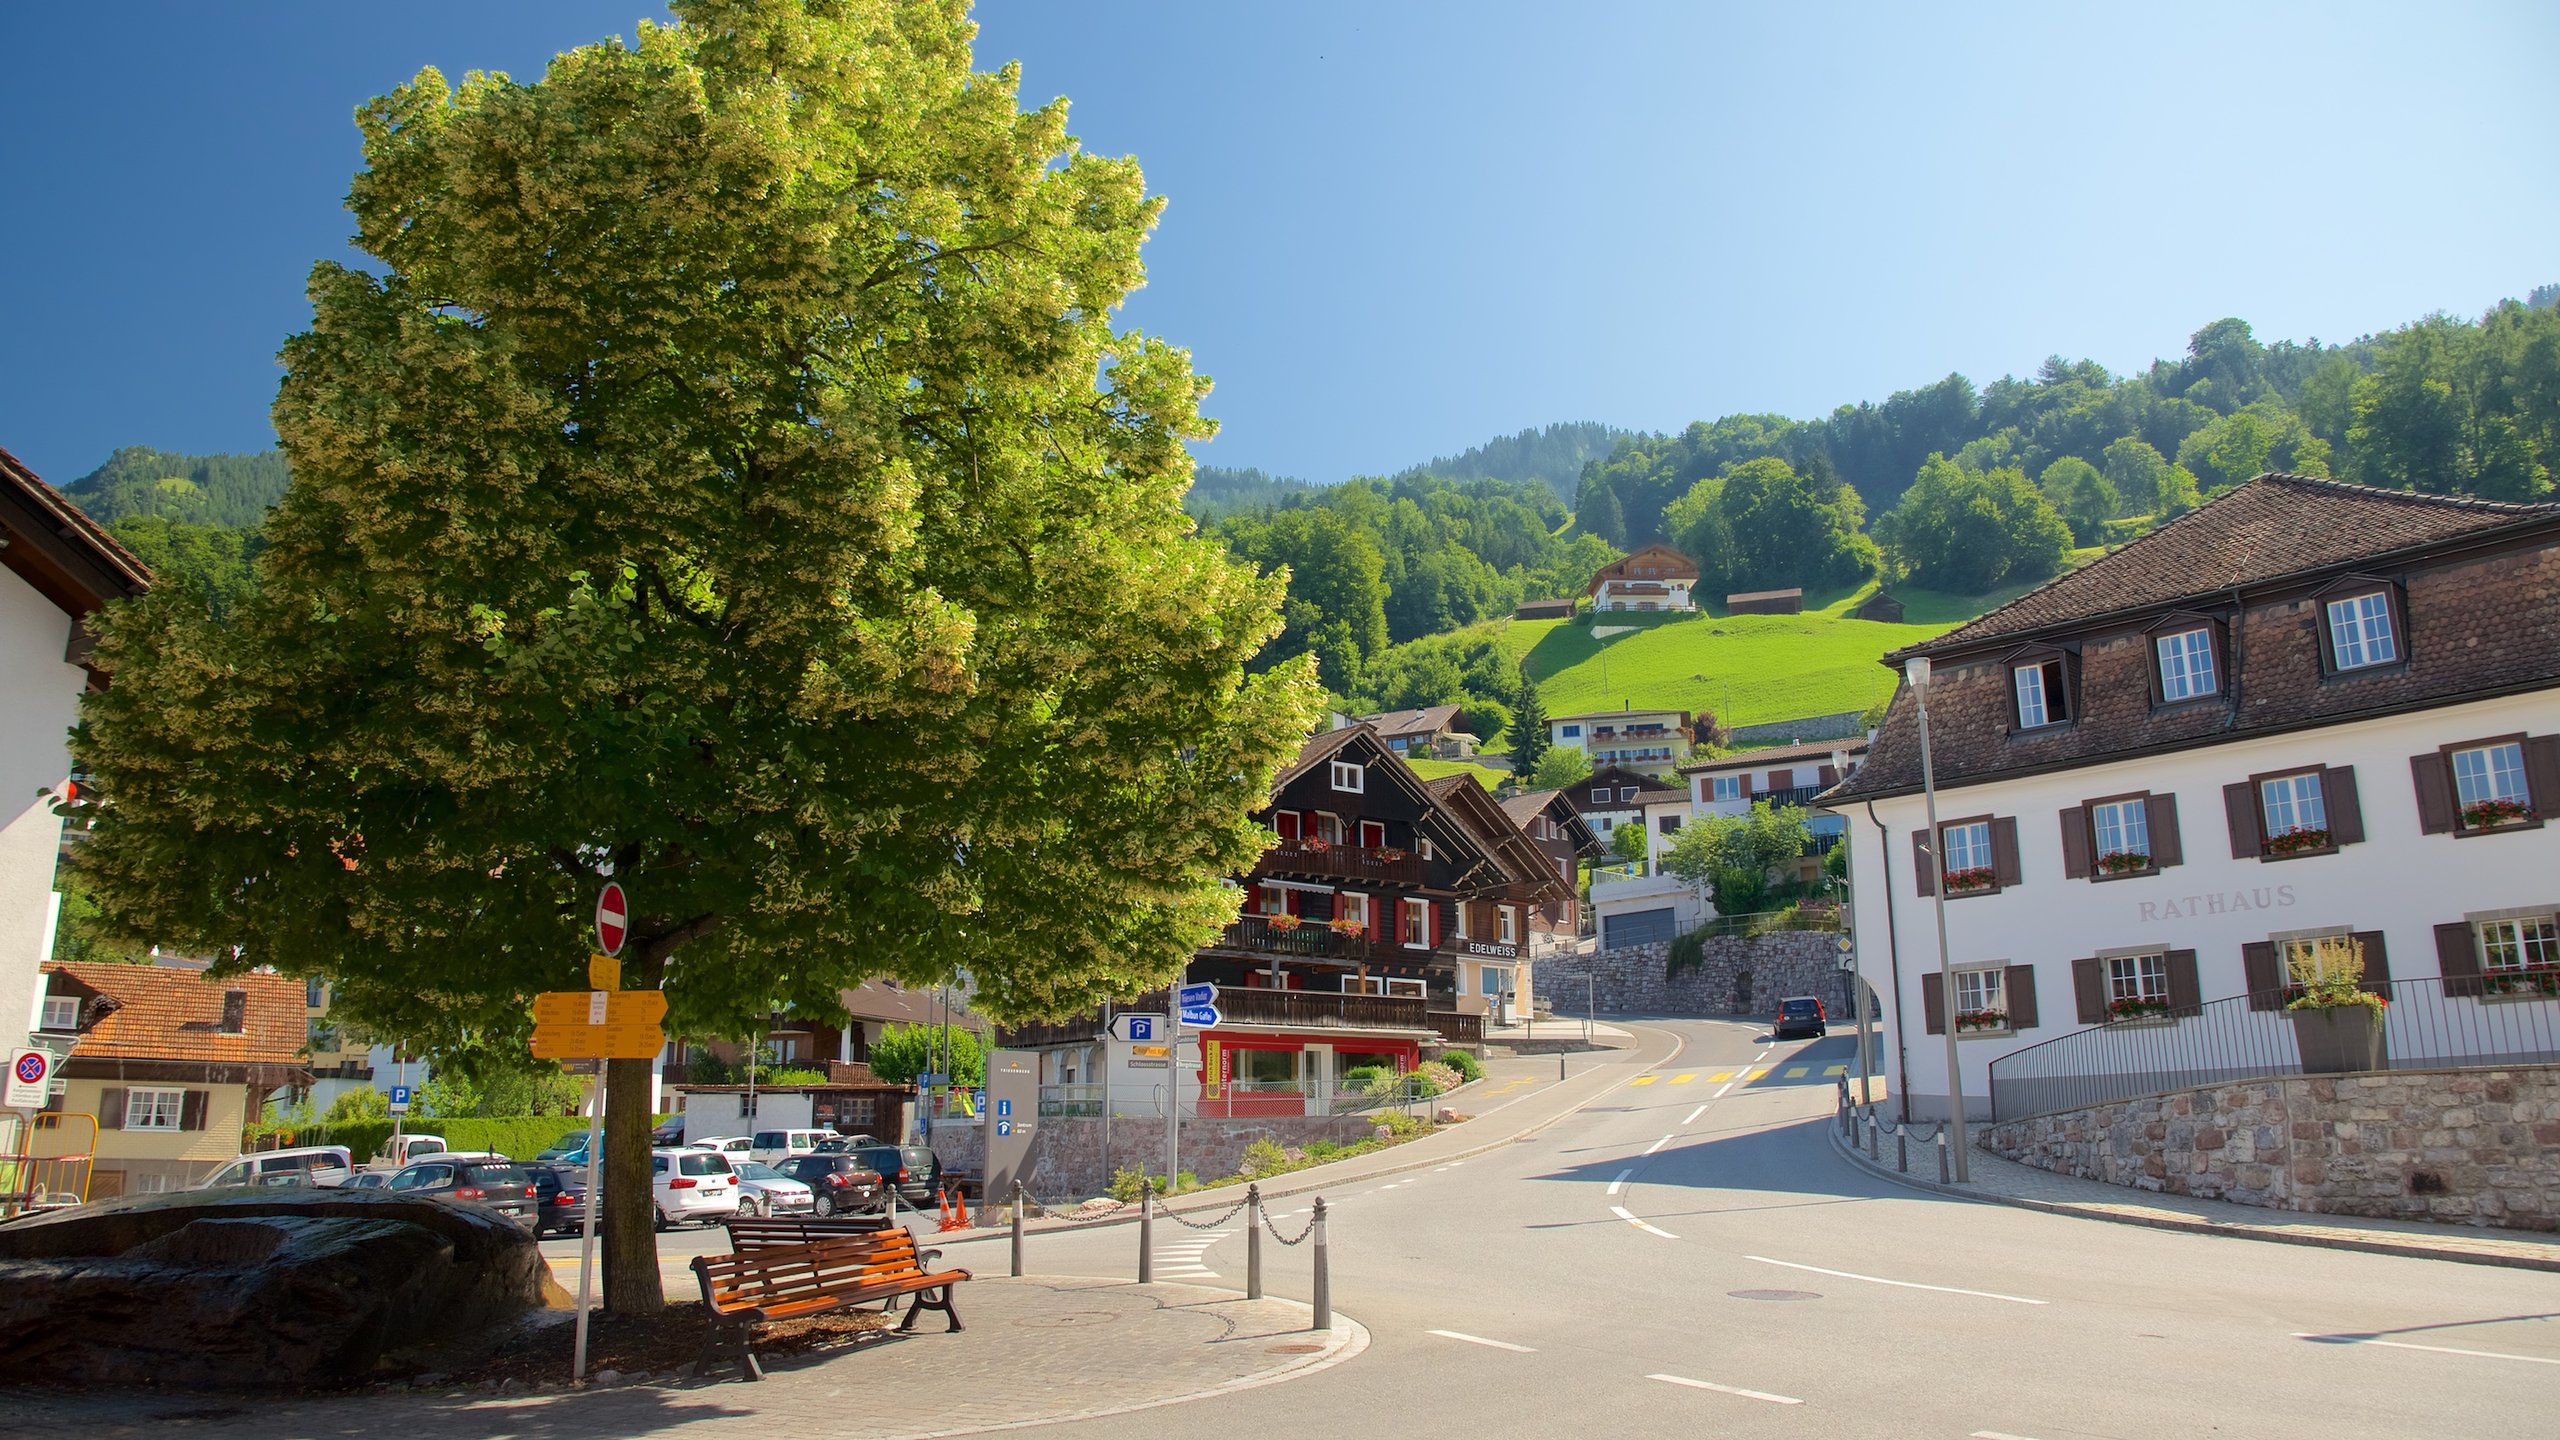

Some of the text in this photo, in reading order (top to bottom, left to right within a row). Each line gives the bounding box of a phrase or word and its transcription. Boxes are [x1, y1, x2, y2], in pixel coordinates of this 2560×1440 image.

[2138, 884, 2296, 922] RATHAUS
[1469, 943, 1516, 957] EDELWEISS
[1182, 1009, 1198, 1020] Malbun
[1136, 1024, 1146, 1037] P
[395, 1089, 406, 1102] P
